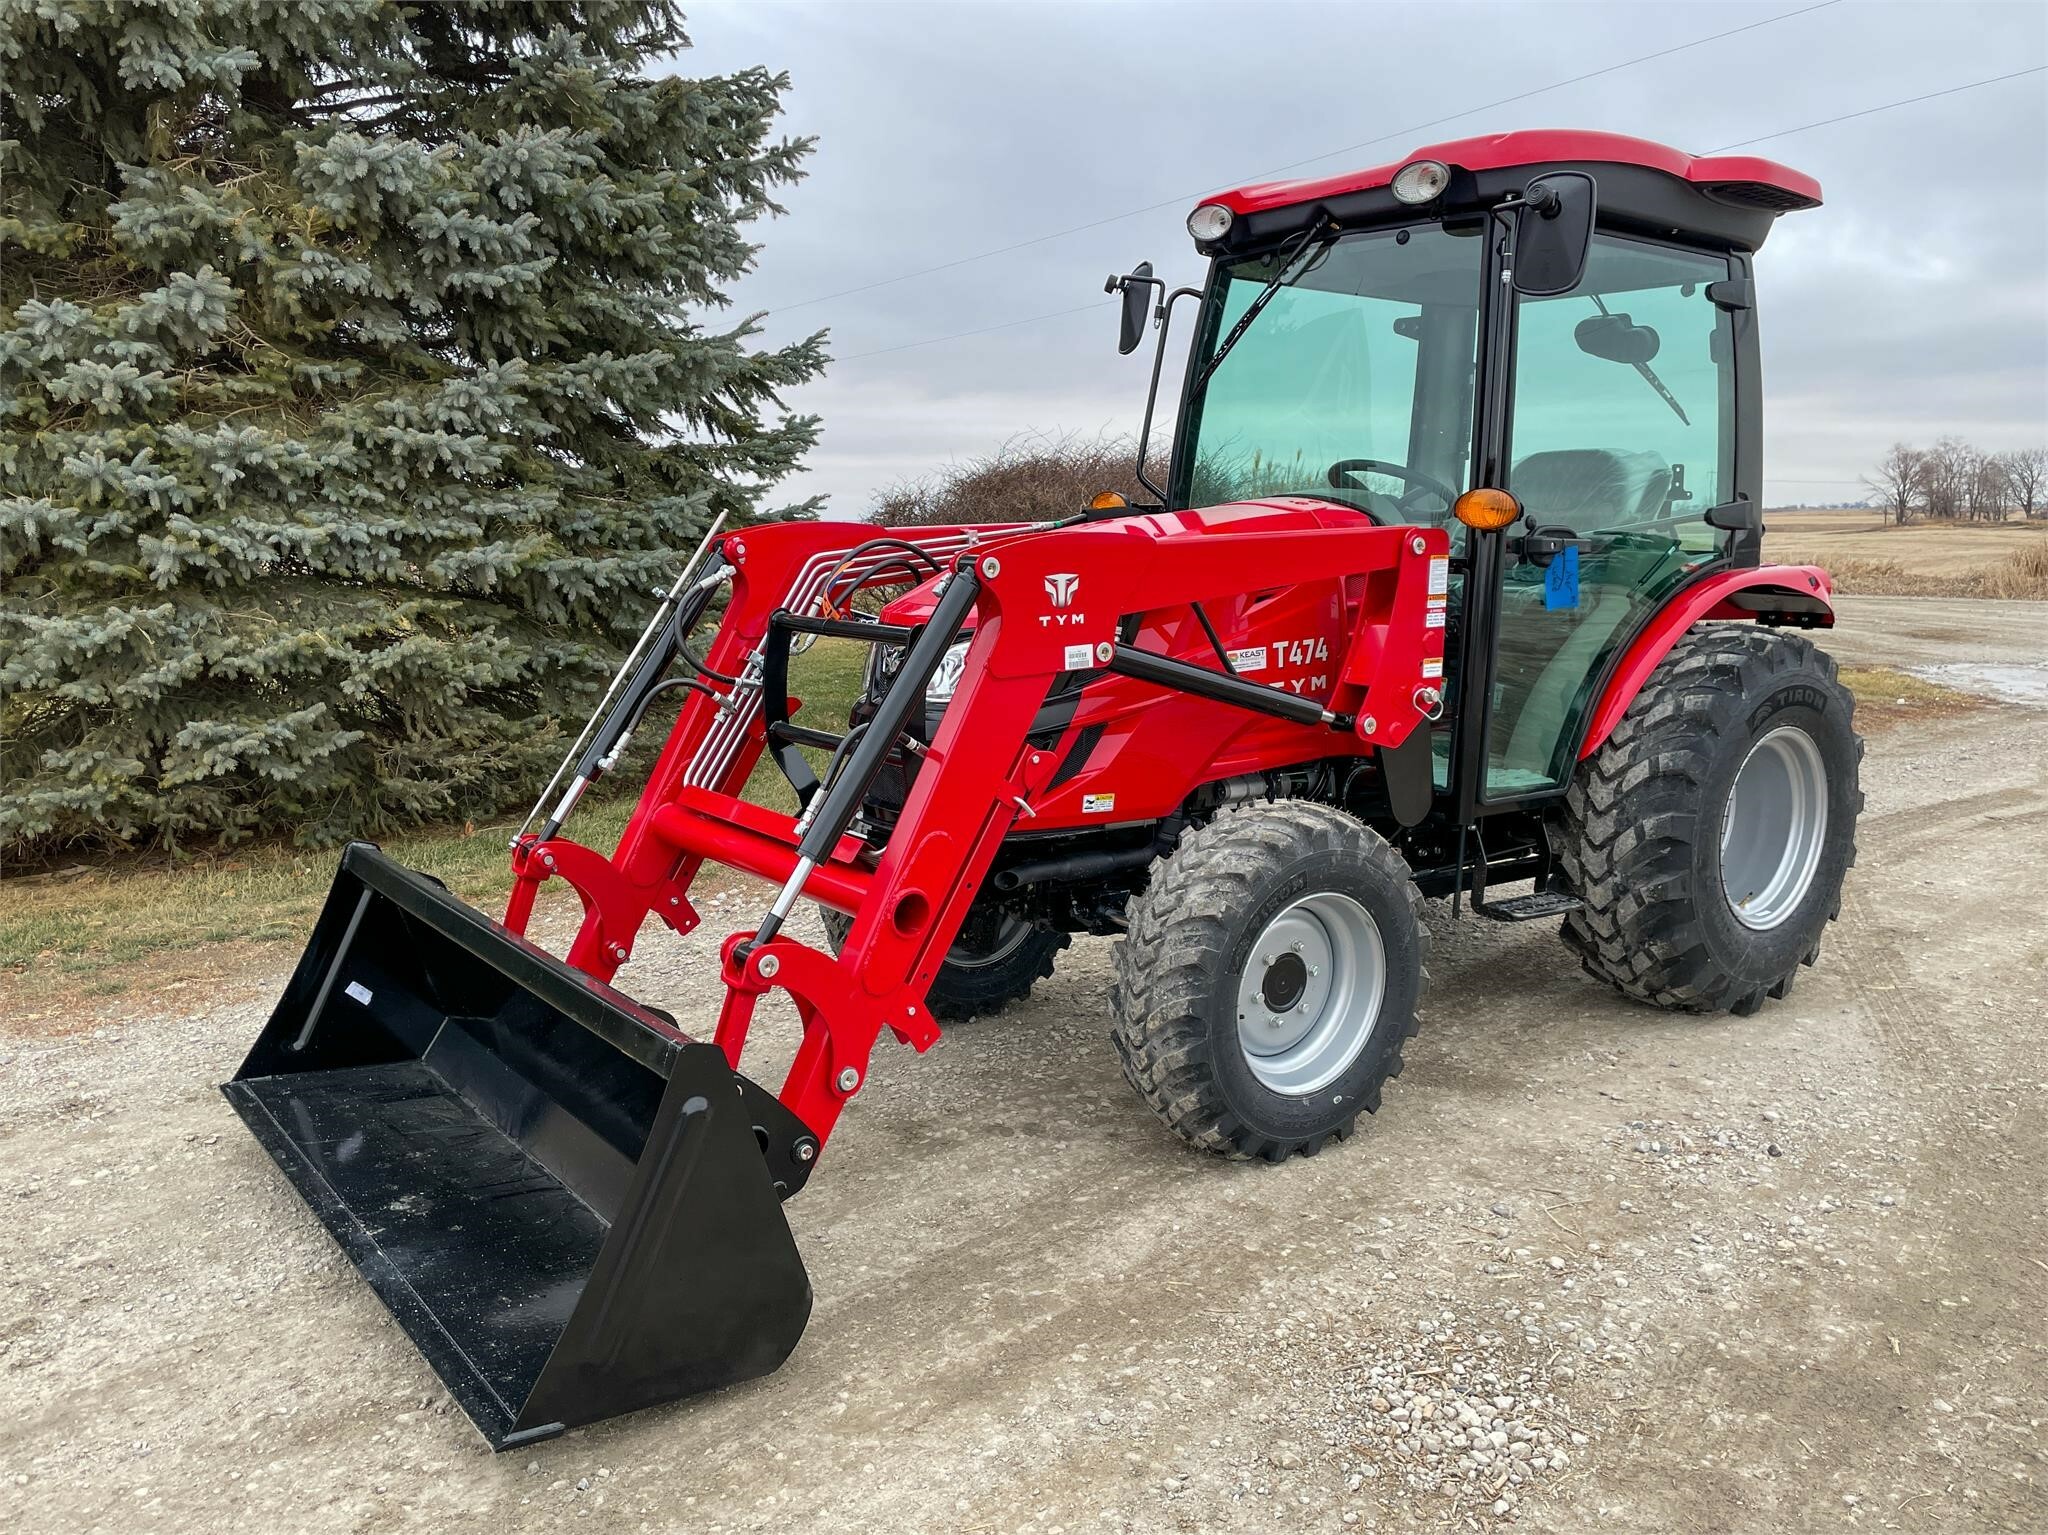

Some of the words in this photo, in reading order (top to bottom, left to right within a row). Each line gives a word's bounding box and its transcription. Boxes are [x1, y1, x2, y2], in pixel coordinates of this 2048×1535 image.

[1039, 613, 1084, 627] TYM
[1240, 649, 1265, 658] KEAST
[1272, 637, 1328, 668] T474
[1777, 688, 1825, 710] TIRON
